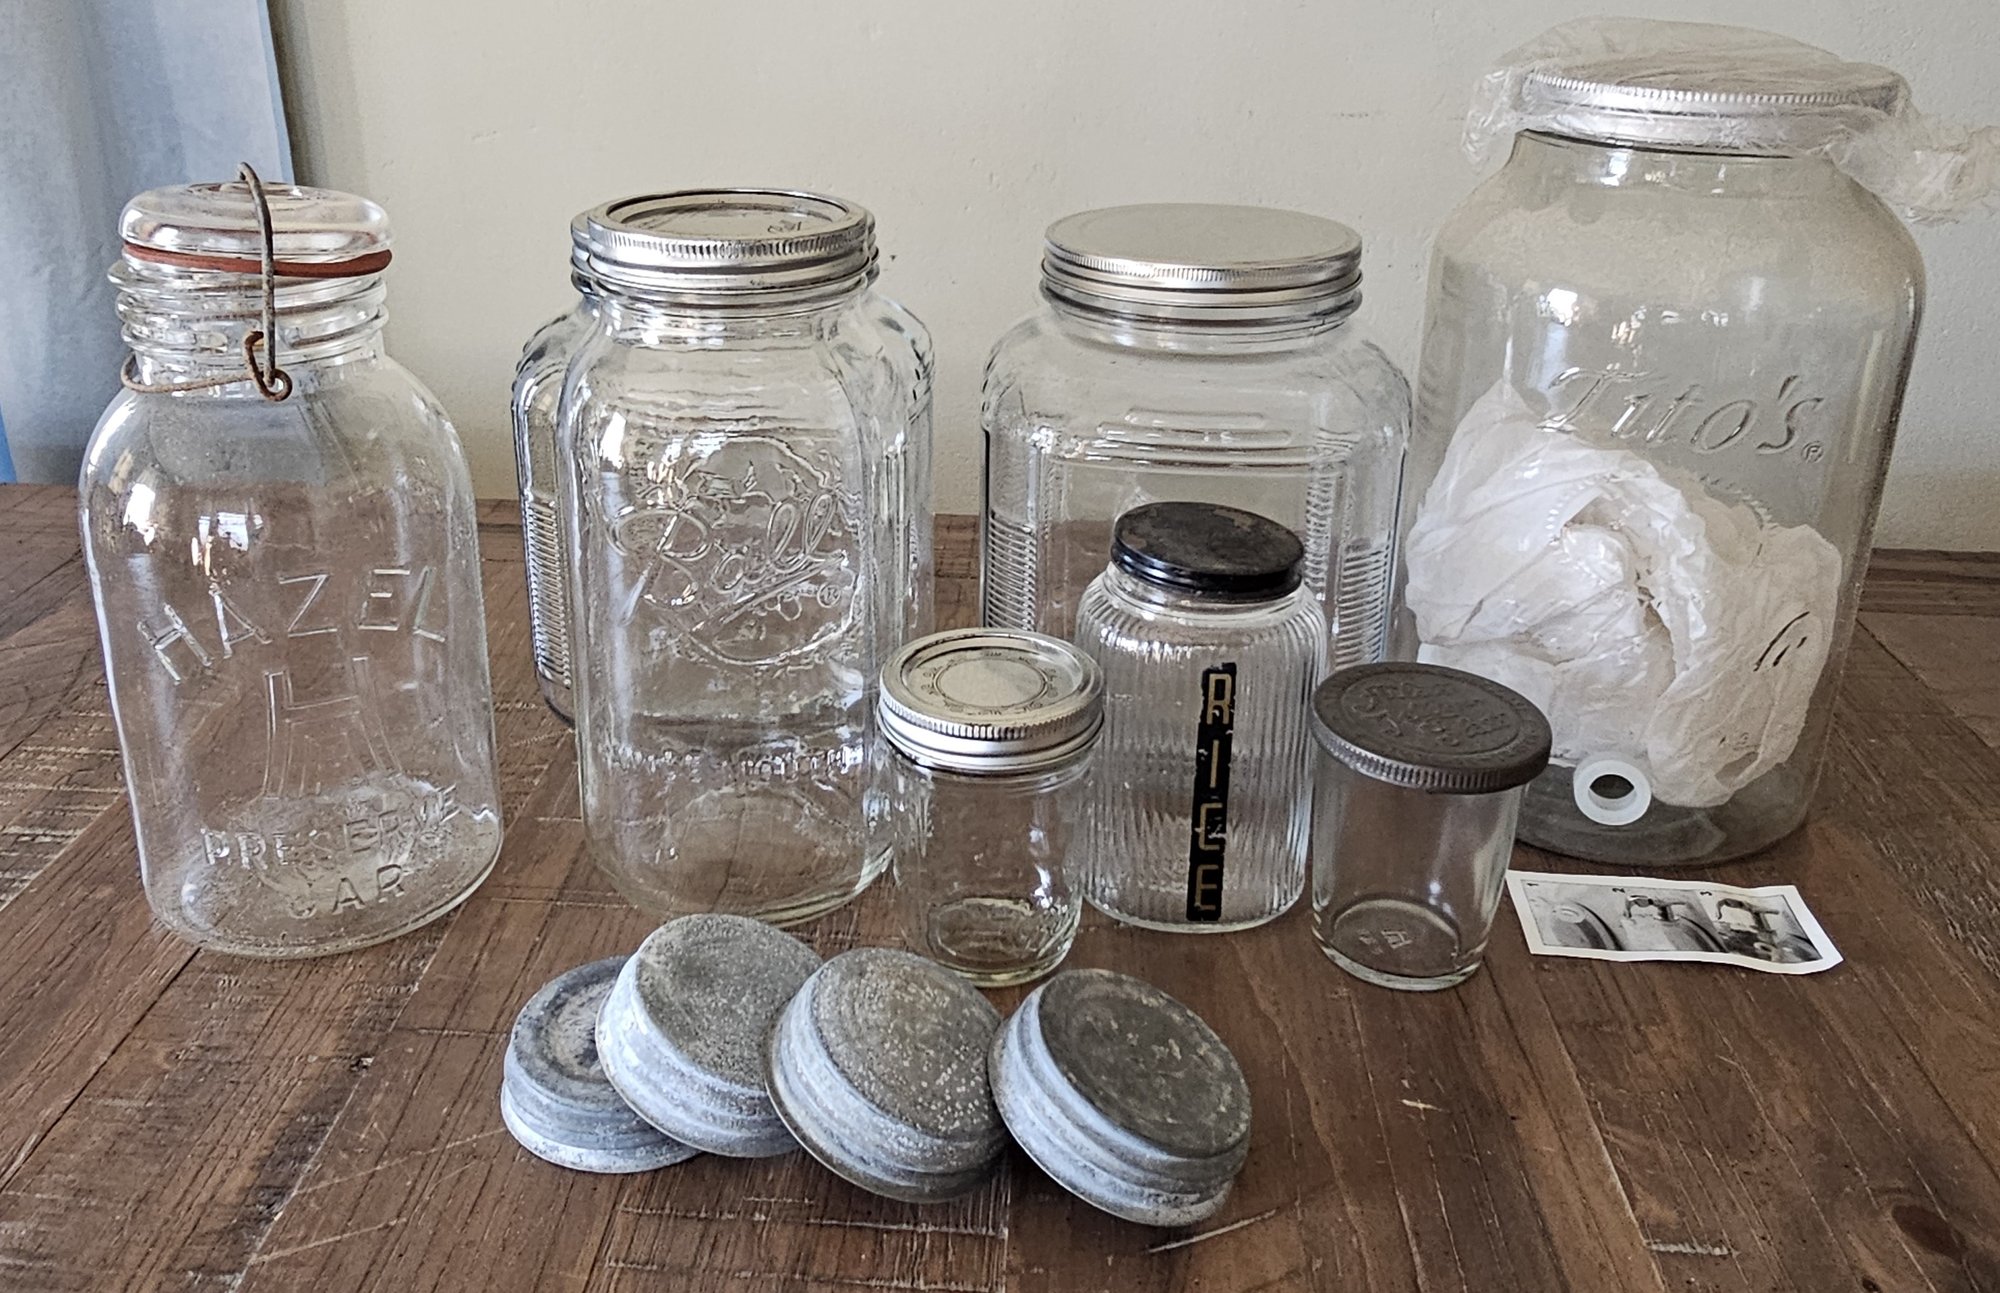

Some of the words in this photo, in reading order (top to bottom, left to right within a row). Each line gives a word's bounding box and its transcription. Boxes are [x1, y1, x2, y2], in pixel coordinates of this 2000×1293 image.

[136, 565, 446, 685] HAZEL
[605, 492, 848, 628] Ball
[1194, 672, 1233, 911] RICE
